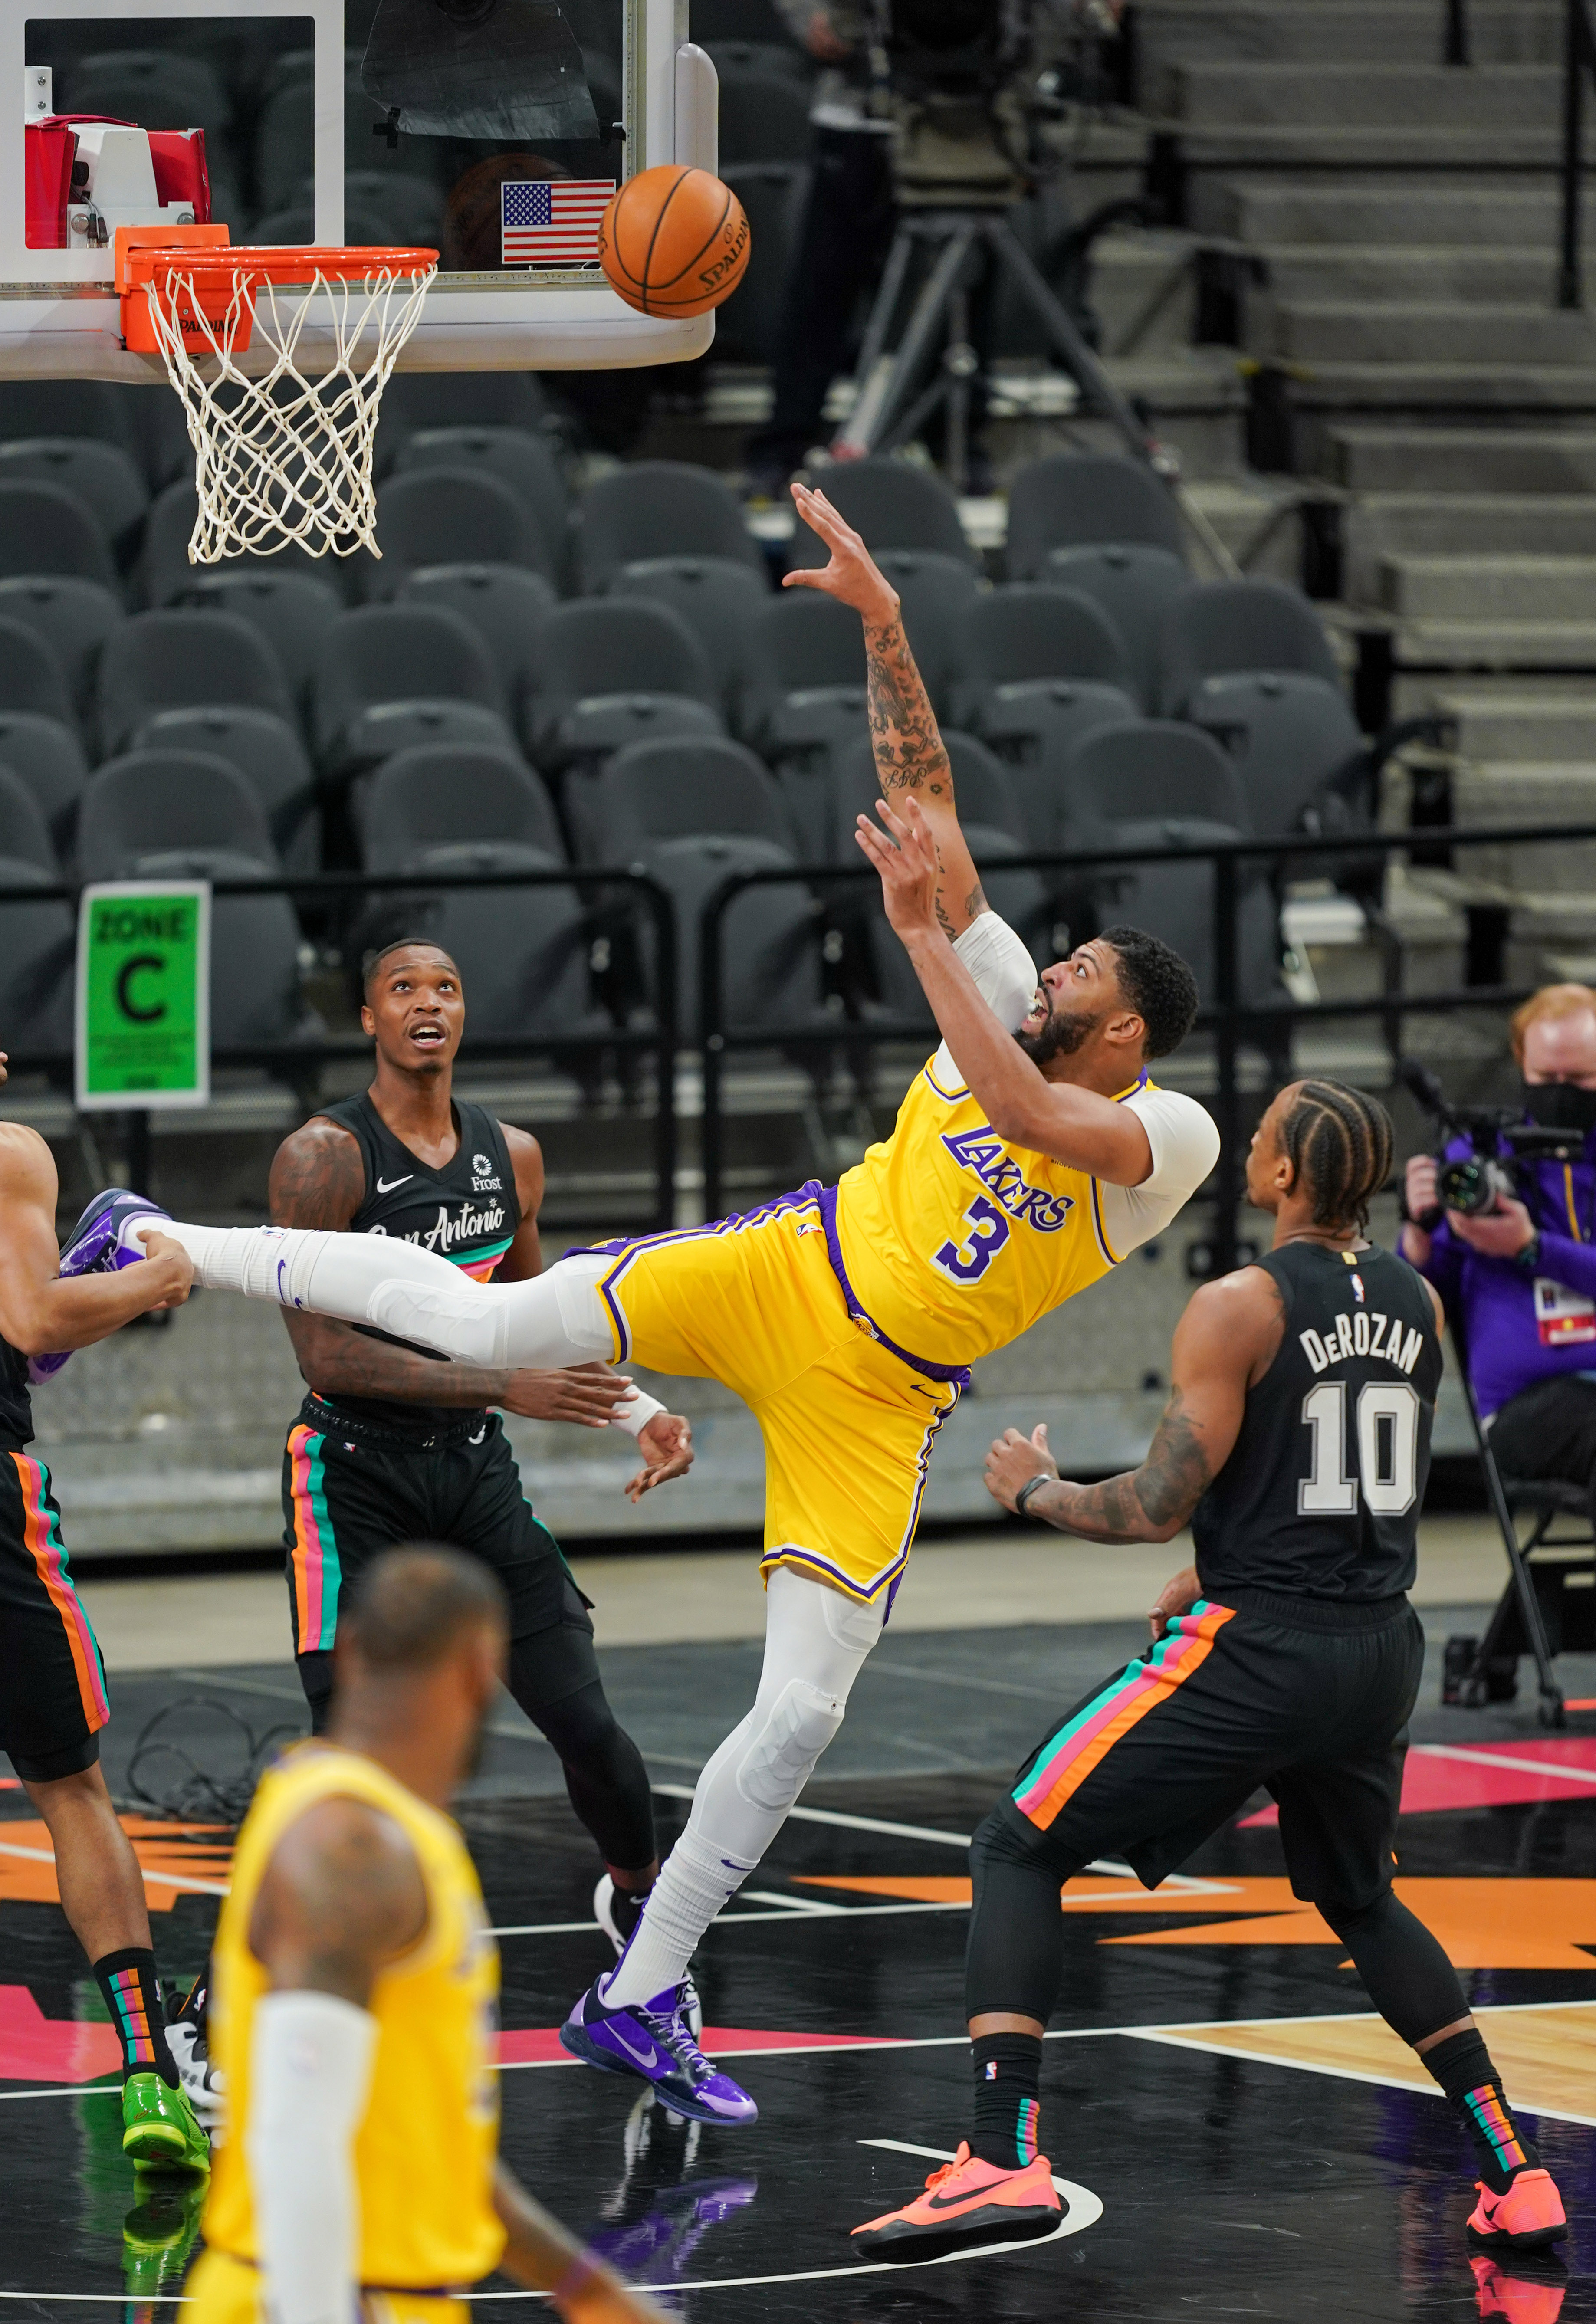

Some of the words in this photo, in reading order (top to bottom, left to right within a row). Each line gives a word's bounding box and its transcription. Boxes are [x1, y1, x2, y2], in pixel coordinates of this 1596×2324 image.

[699, 218, 750, 291] SPALDIN
[173, 318, 238, 334] PALING
[99, 909, 184, 943] ZONE
[115, 954, 167, 1022] C
[470, 1176, 502, 1191] Frost
[939, 1122, 1076, 1233] LAKERS
[424, 1197, 505, 1252] Antonio
[929, 1192, 1011, 1285] 3
[1297, 1380, 1420, 1516] 10
